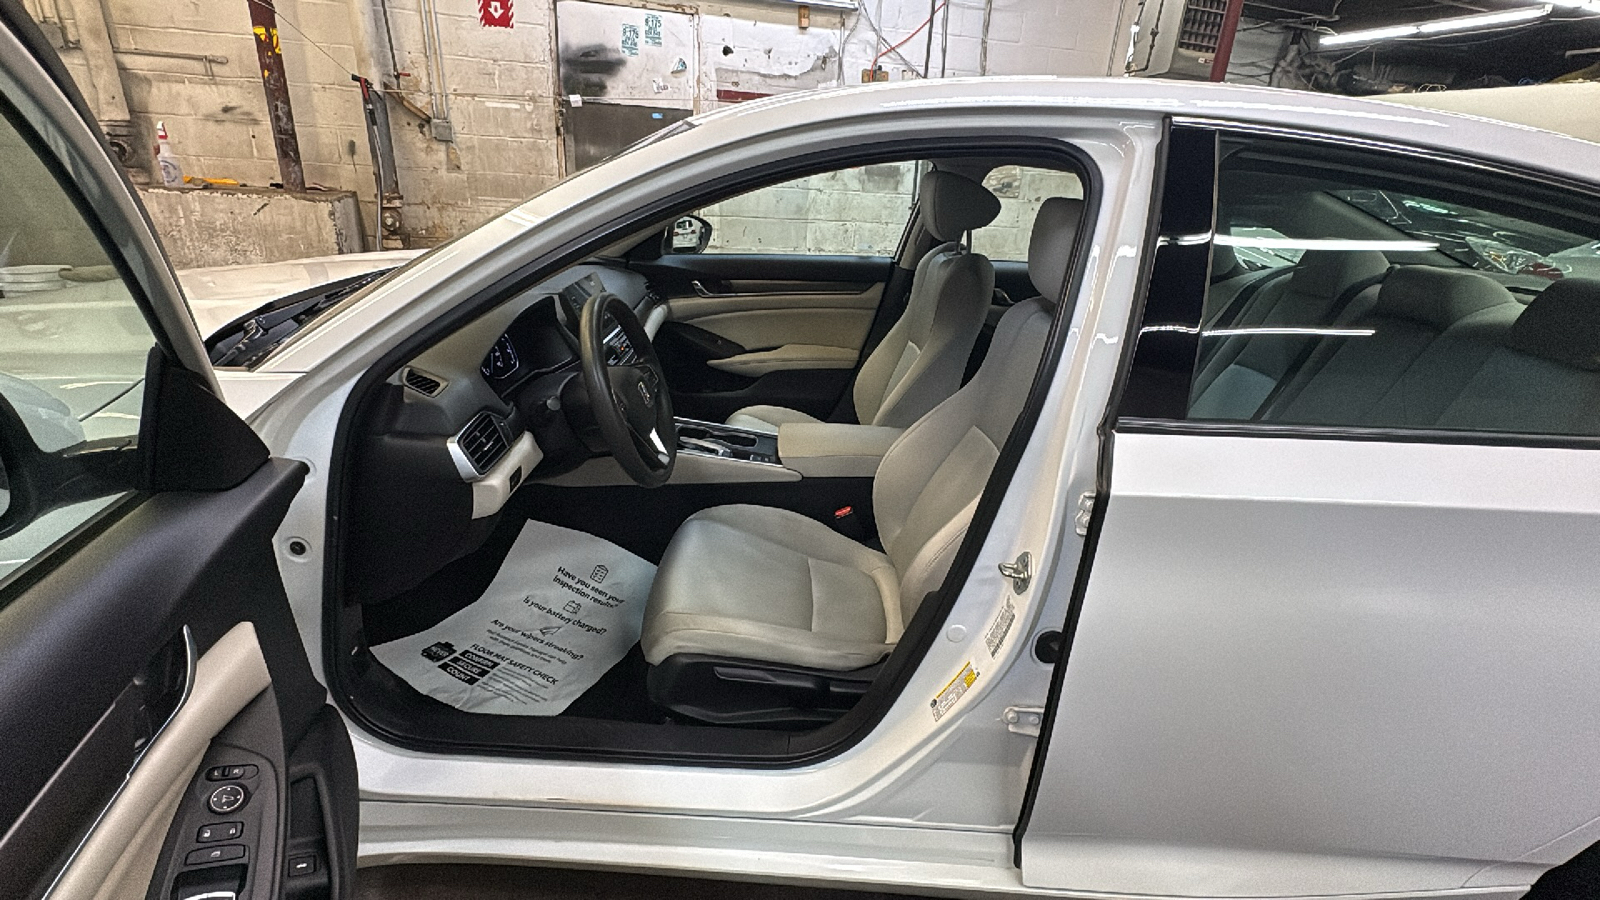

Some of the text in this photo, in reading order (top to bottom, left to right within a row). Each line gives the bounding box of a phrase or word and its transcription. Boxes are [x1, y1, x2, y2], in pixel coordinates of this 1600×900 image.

[557, 566, 577, 581] Have
[575, 578, 591, 589] you
[590, 586, 608, 598] seen
[490, 619, 505, 628] Are
[501, 625, 522, 634] your
[528, 601, 547, 612] your
[546, 607, 573, 625] battery
[572, 619, 607, 635] charged?
[446, 666, 471, 681] COUNT
[469, 643, 494, 657] FLOOR
[507, 660, 535, 672] SAFETY
[532, 669, 559, 685] CHECK
